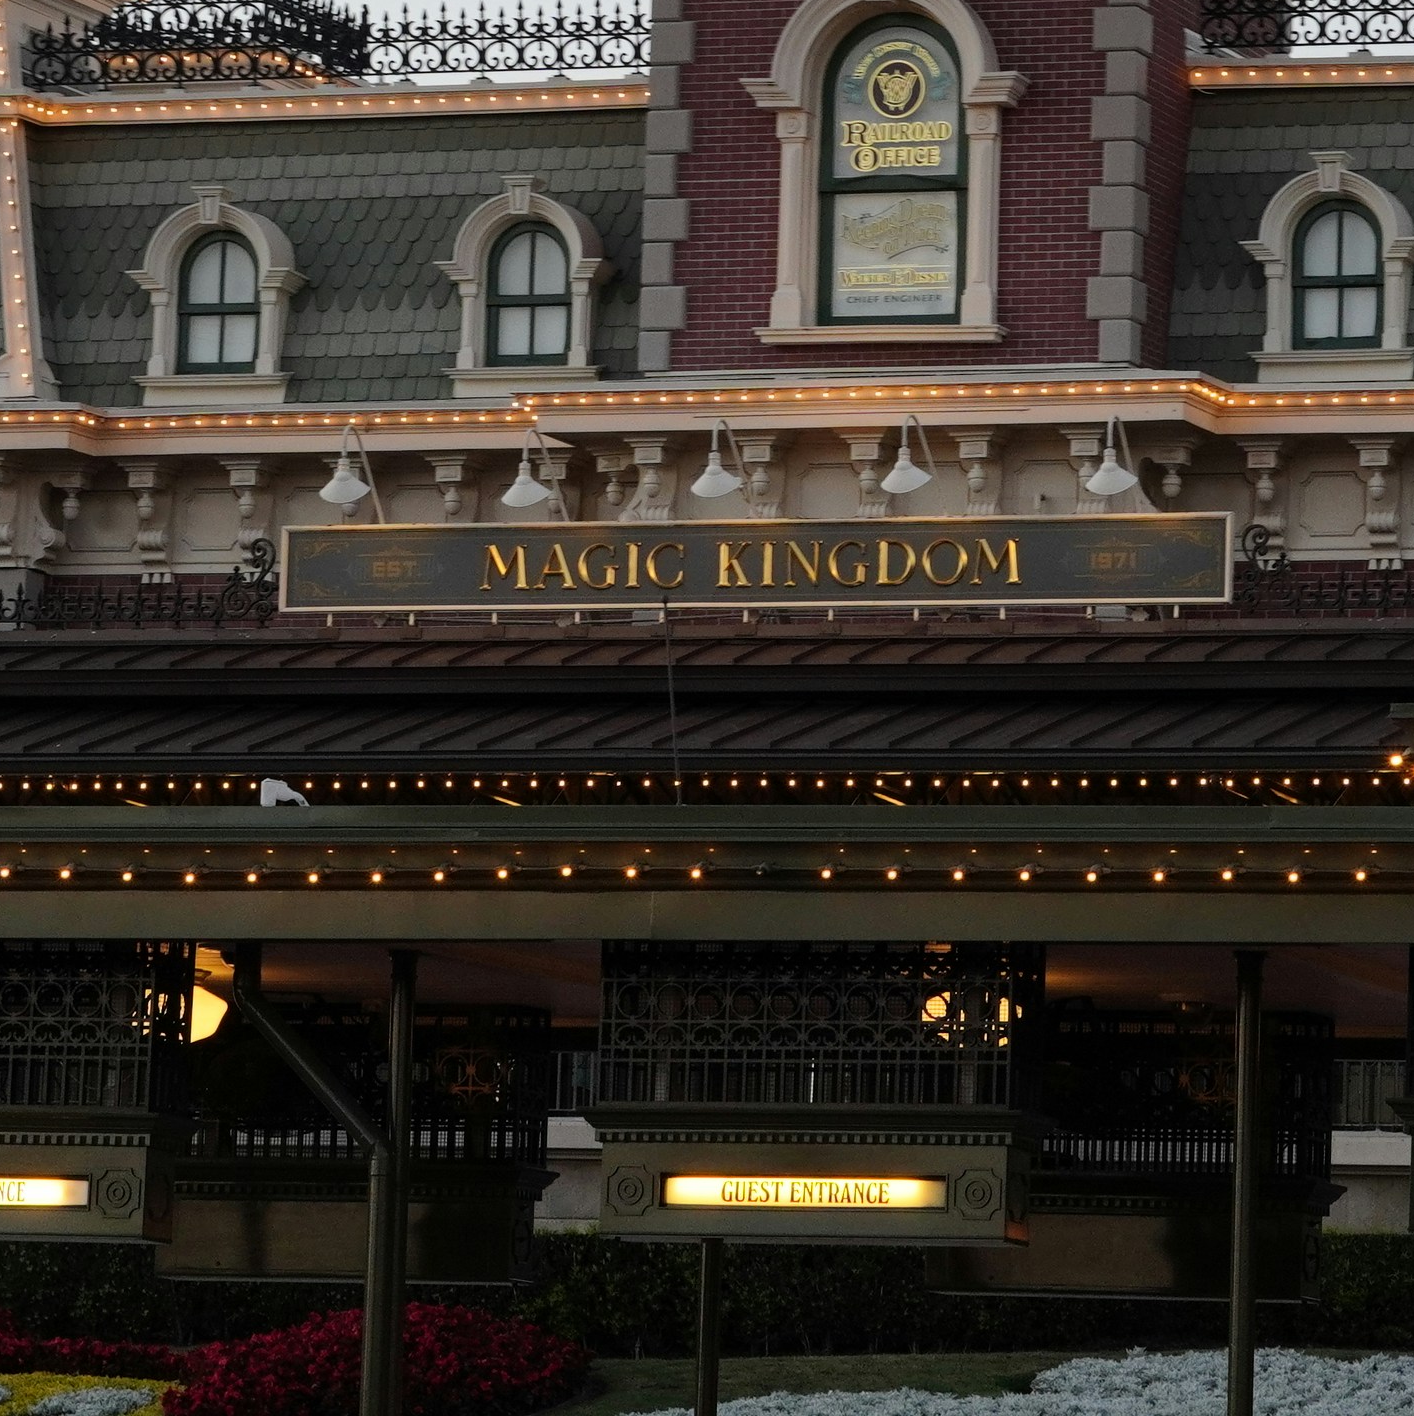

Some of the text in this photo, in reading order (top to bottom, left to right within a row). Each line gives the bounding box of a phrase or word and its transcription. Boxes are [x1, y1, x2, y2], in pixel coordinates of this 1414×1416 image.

[841, 120, 952, 146] RAILROAD
[850, 145, 941, 172] OFFICE
[846, 293, 944, 304] CHIEF ENGINEER
[479, 537, 1023, 590] MAGIC KINGDOM
[1090, 551, 1138, 570] 1971
[721, 1180, 890, 1204] GUEST ENTRANCE
